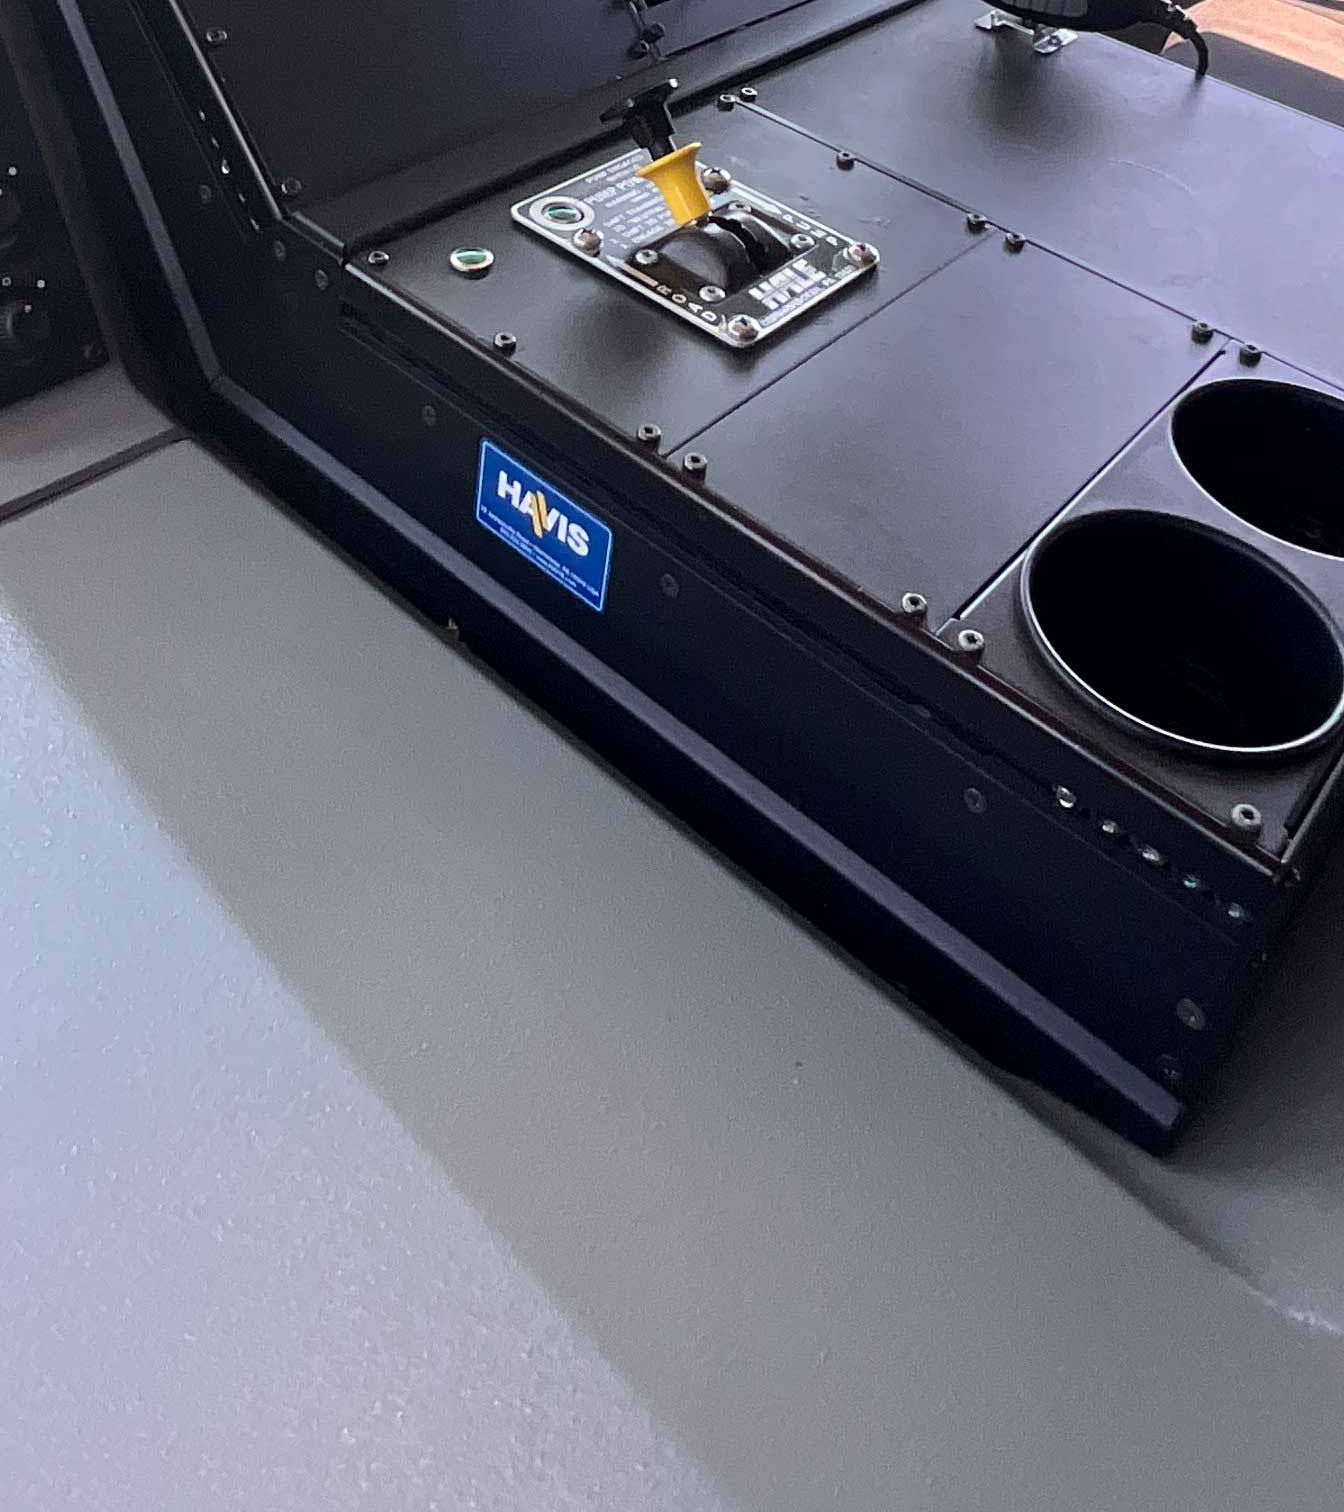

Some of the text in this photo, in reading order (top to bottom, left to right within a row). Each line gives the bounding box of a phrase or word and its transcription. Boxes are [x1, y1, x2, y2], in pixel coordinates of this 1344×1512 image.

[782, 214, 839, 247] PUMP
[656, 284, 718, 323] ROAD
[748, 257, 827, 311] HALE
[497, 469, 591, 558] HAVIS
